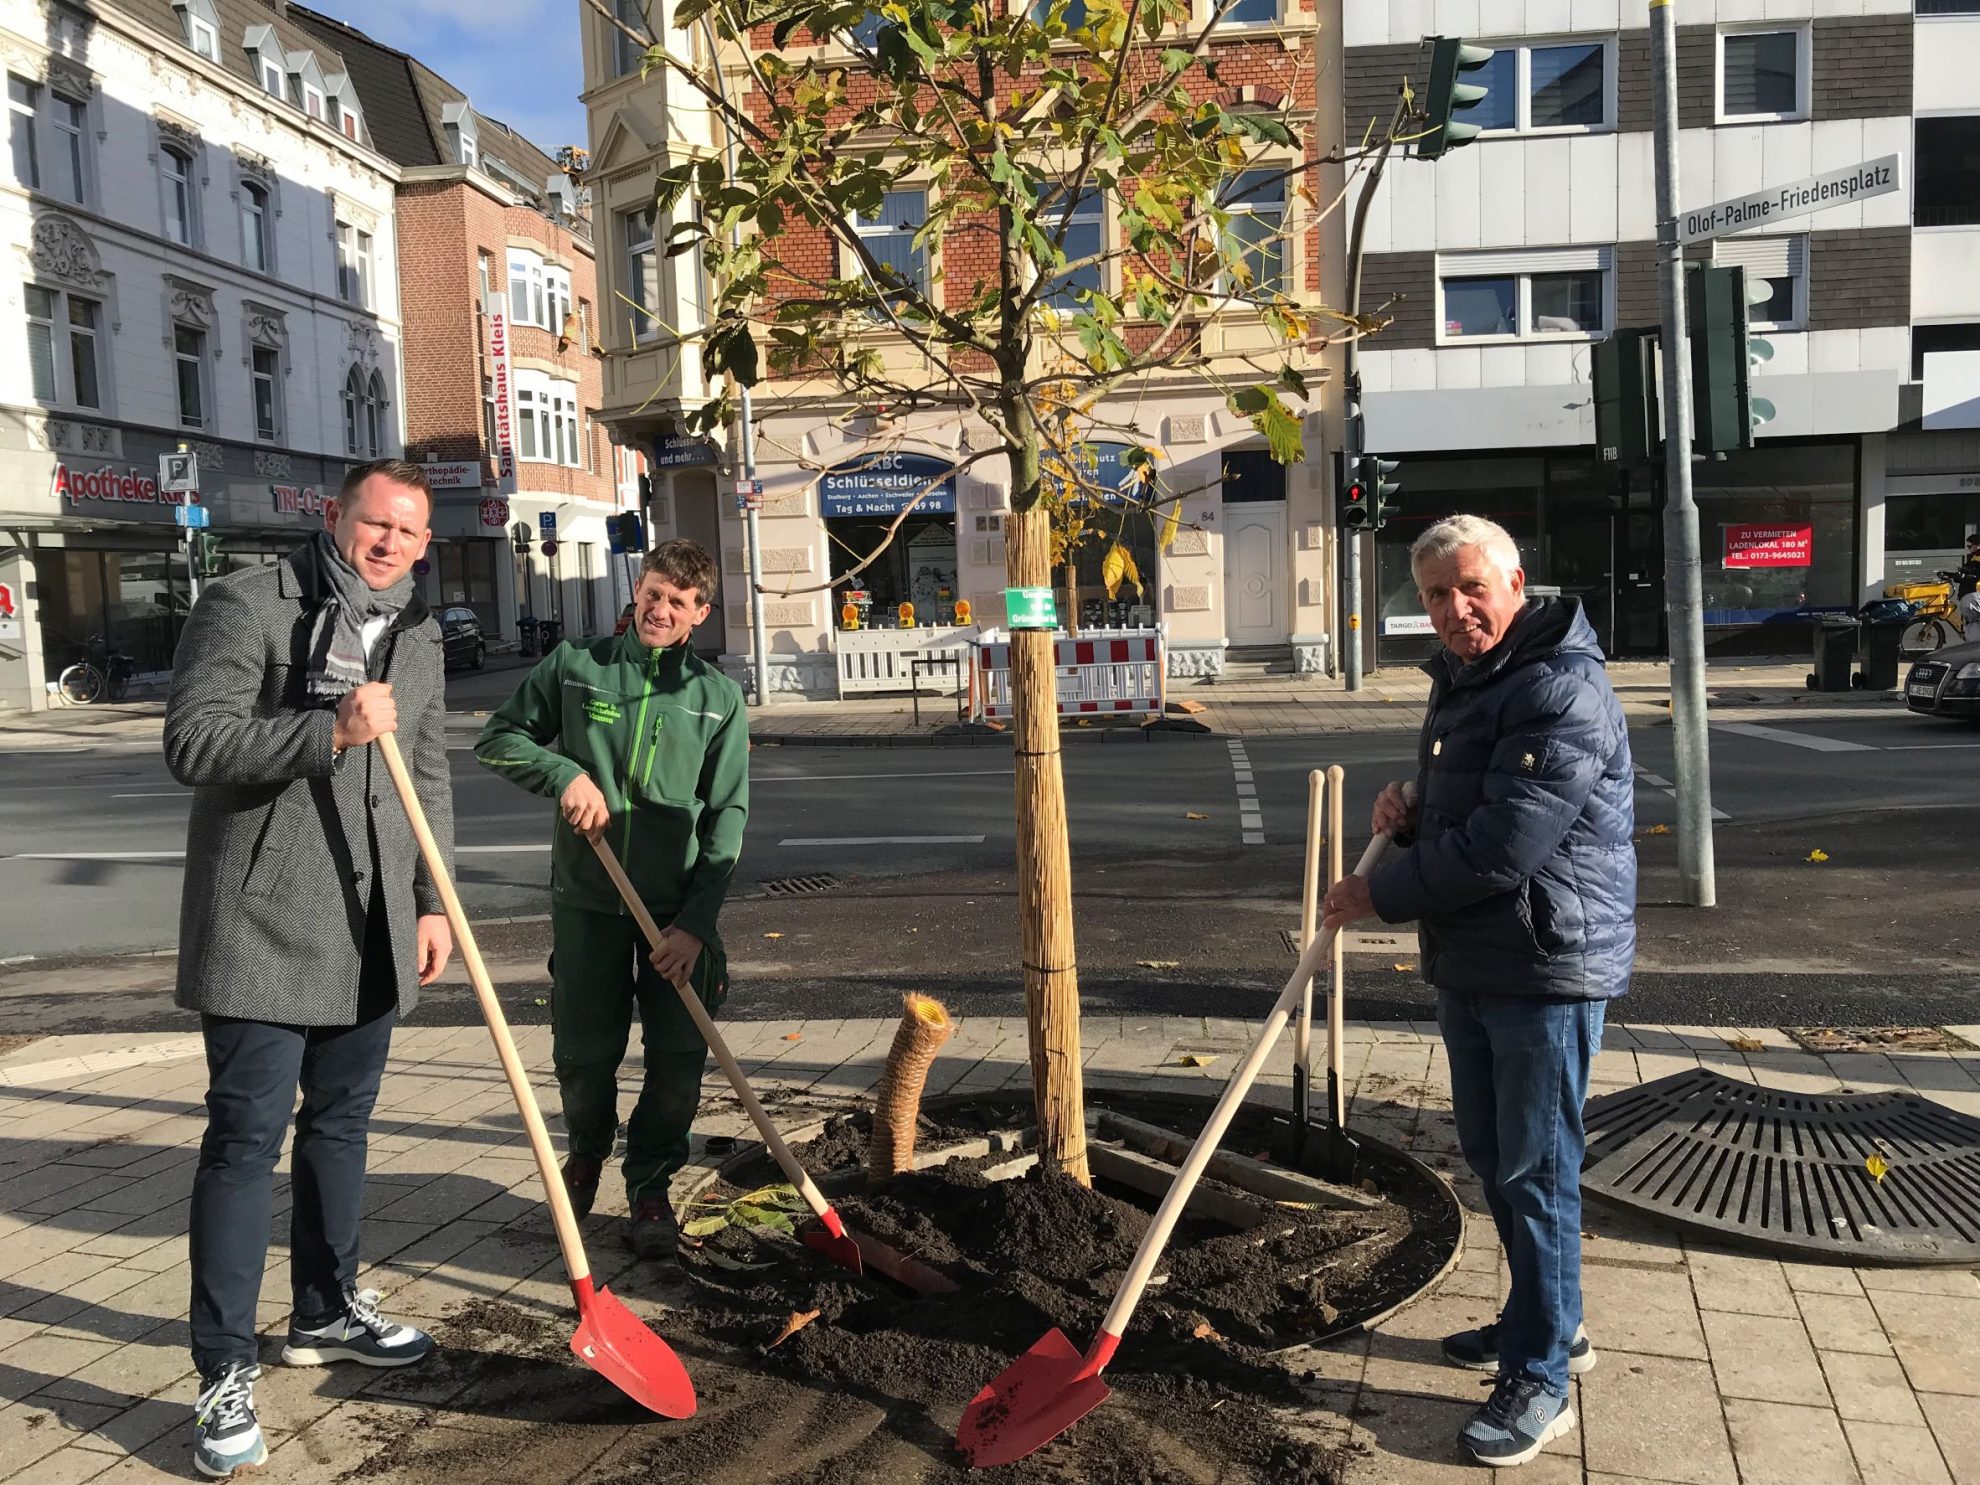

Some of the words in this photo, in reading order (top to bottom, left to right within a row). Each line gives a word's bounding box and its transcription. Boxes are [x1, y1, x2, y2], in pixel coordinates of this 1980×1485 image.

[1688, 167, 1890, 235] Olof-Palme-Friedensplatz
[490, 313, 505, 357] Kleis
[495, 363, 512, 478] Sanitätshaus
[660, 453, 674, 465] und
[423, 465, 472, 476] rthopädie-
[51, 462, 157, 506] Apotheke
[429, 476, 462, 486] technik
[857, 492, 879, 500] Aachen
[835, 504, 854, 514] Tag
[855, 503, 864, 513] &
[866, 502, 896, 512] Nacht
[929, 500, 942, 510] 98
[1201, 511, 1215, 522] 84
[1740, 531, 1752, 539] ZU
[1753, 530, 1798, 538] VERMIETEN
[1728, 541, 1780, 550] LADENLOKAL
[1781, 541, 1796, 549] 180
